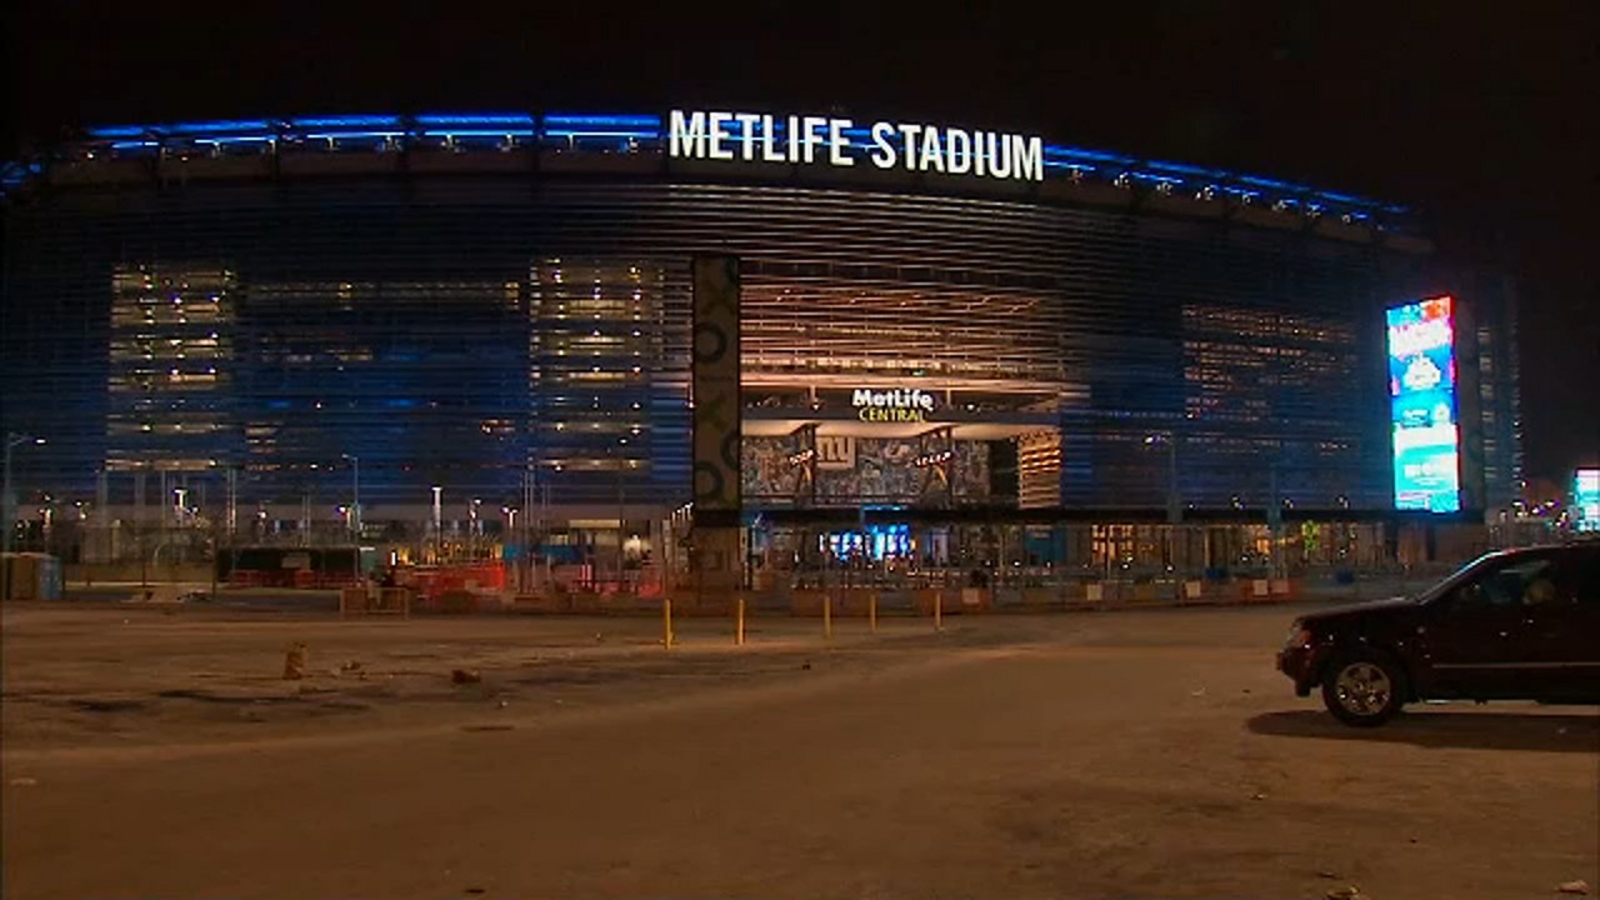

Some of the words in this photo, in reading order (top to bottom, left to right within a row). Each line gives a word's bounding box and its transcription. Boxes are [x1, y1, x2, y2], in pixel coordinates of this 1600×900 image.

[669, 110, 854, 167] METLIFE
[870, 121, 1044, 182] STADIUM
[852, 388, 934, 412] MetLife
[859, 407, 926, 423] CENTRAL
